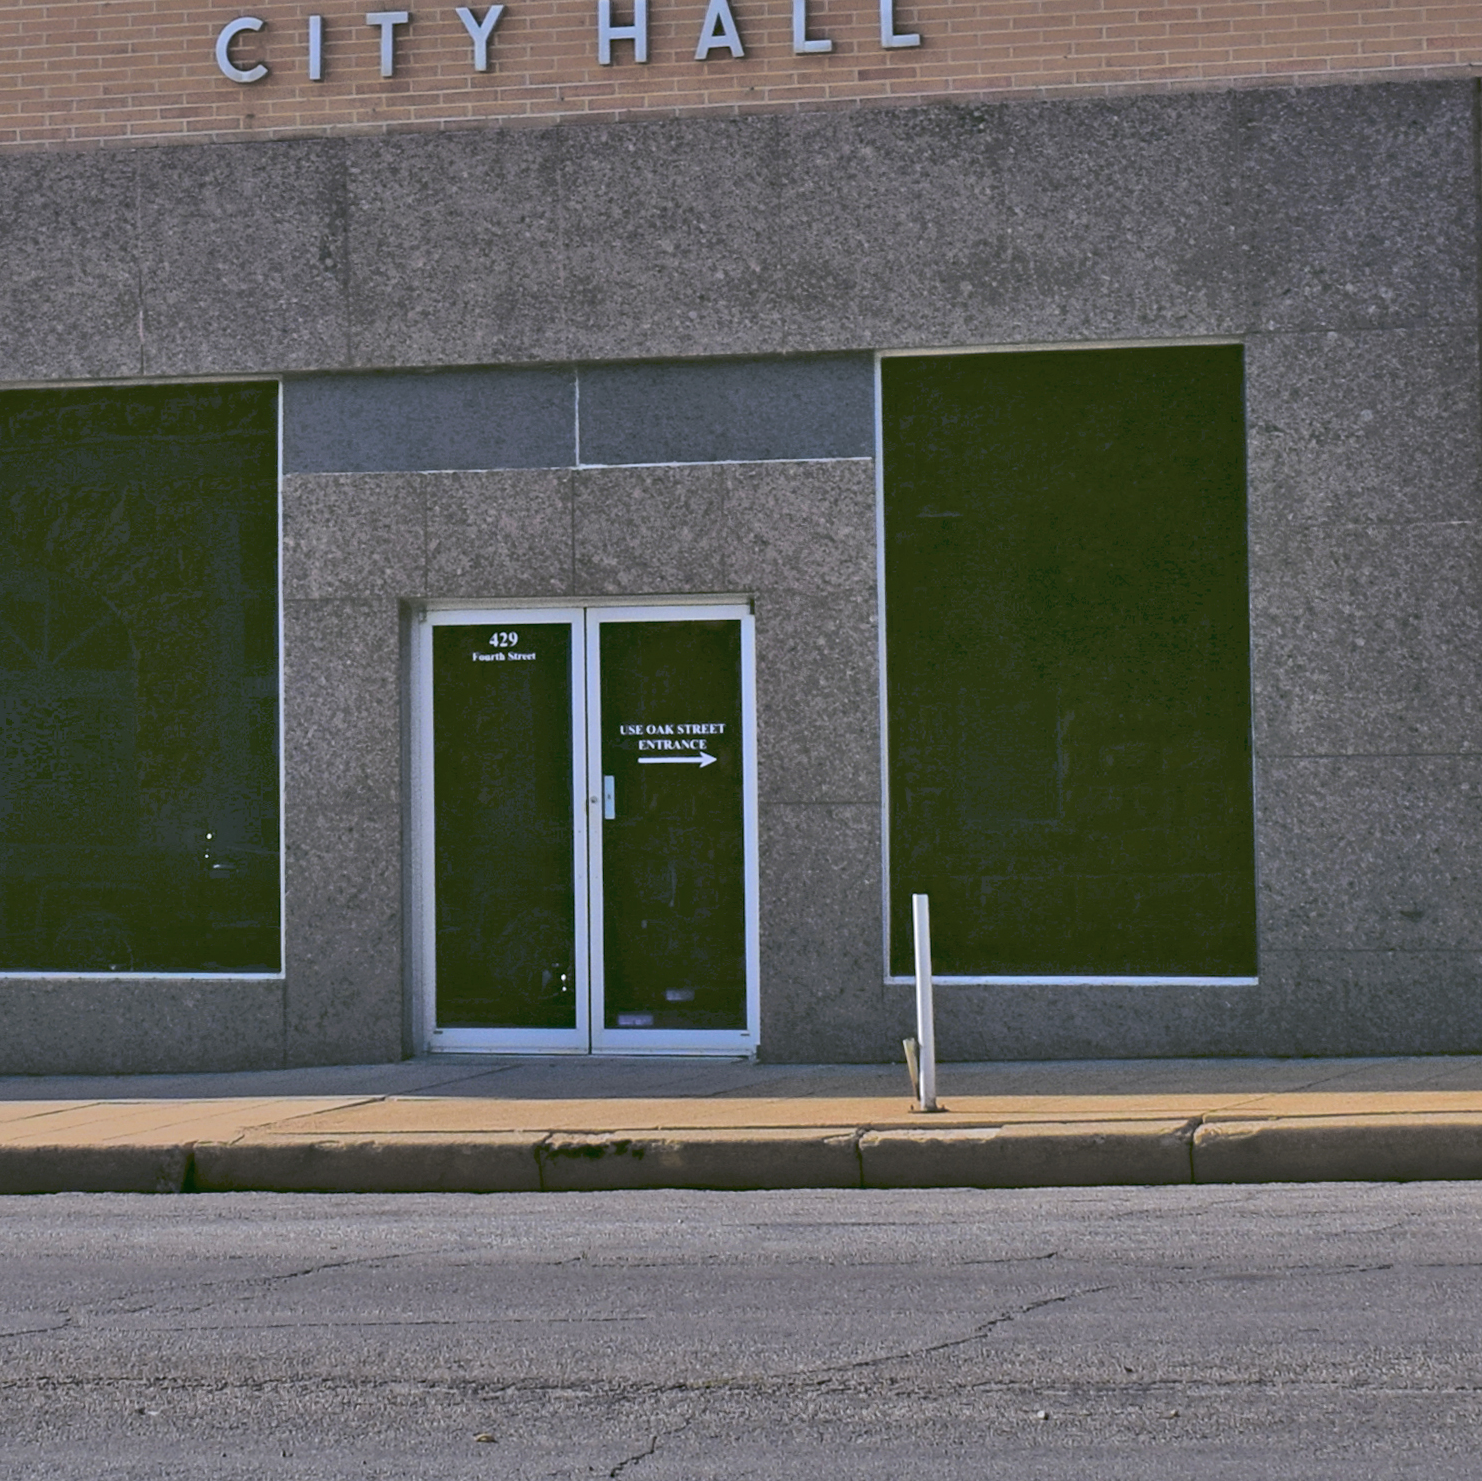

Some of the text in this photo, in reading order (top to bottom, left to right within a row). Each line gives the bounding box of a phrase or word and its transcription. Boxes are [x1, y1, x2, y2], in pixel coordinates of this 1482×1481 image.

[214, 3, 505, 84] CITY
[488, 631, 519, 648] 429
[472, 651, 537, 662] Fourth Street
[620, 723, 725, 735] USE OAK STREET
[638, 739, 707, 750] ENTRANCE
